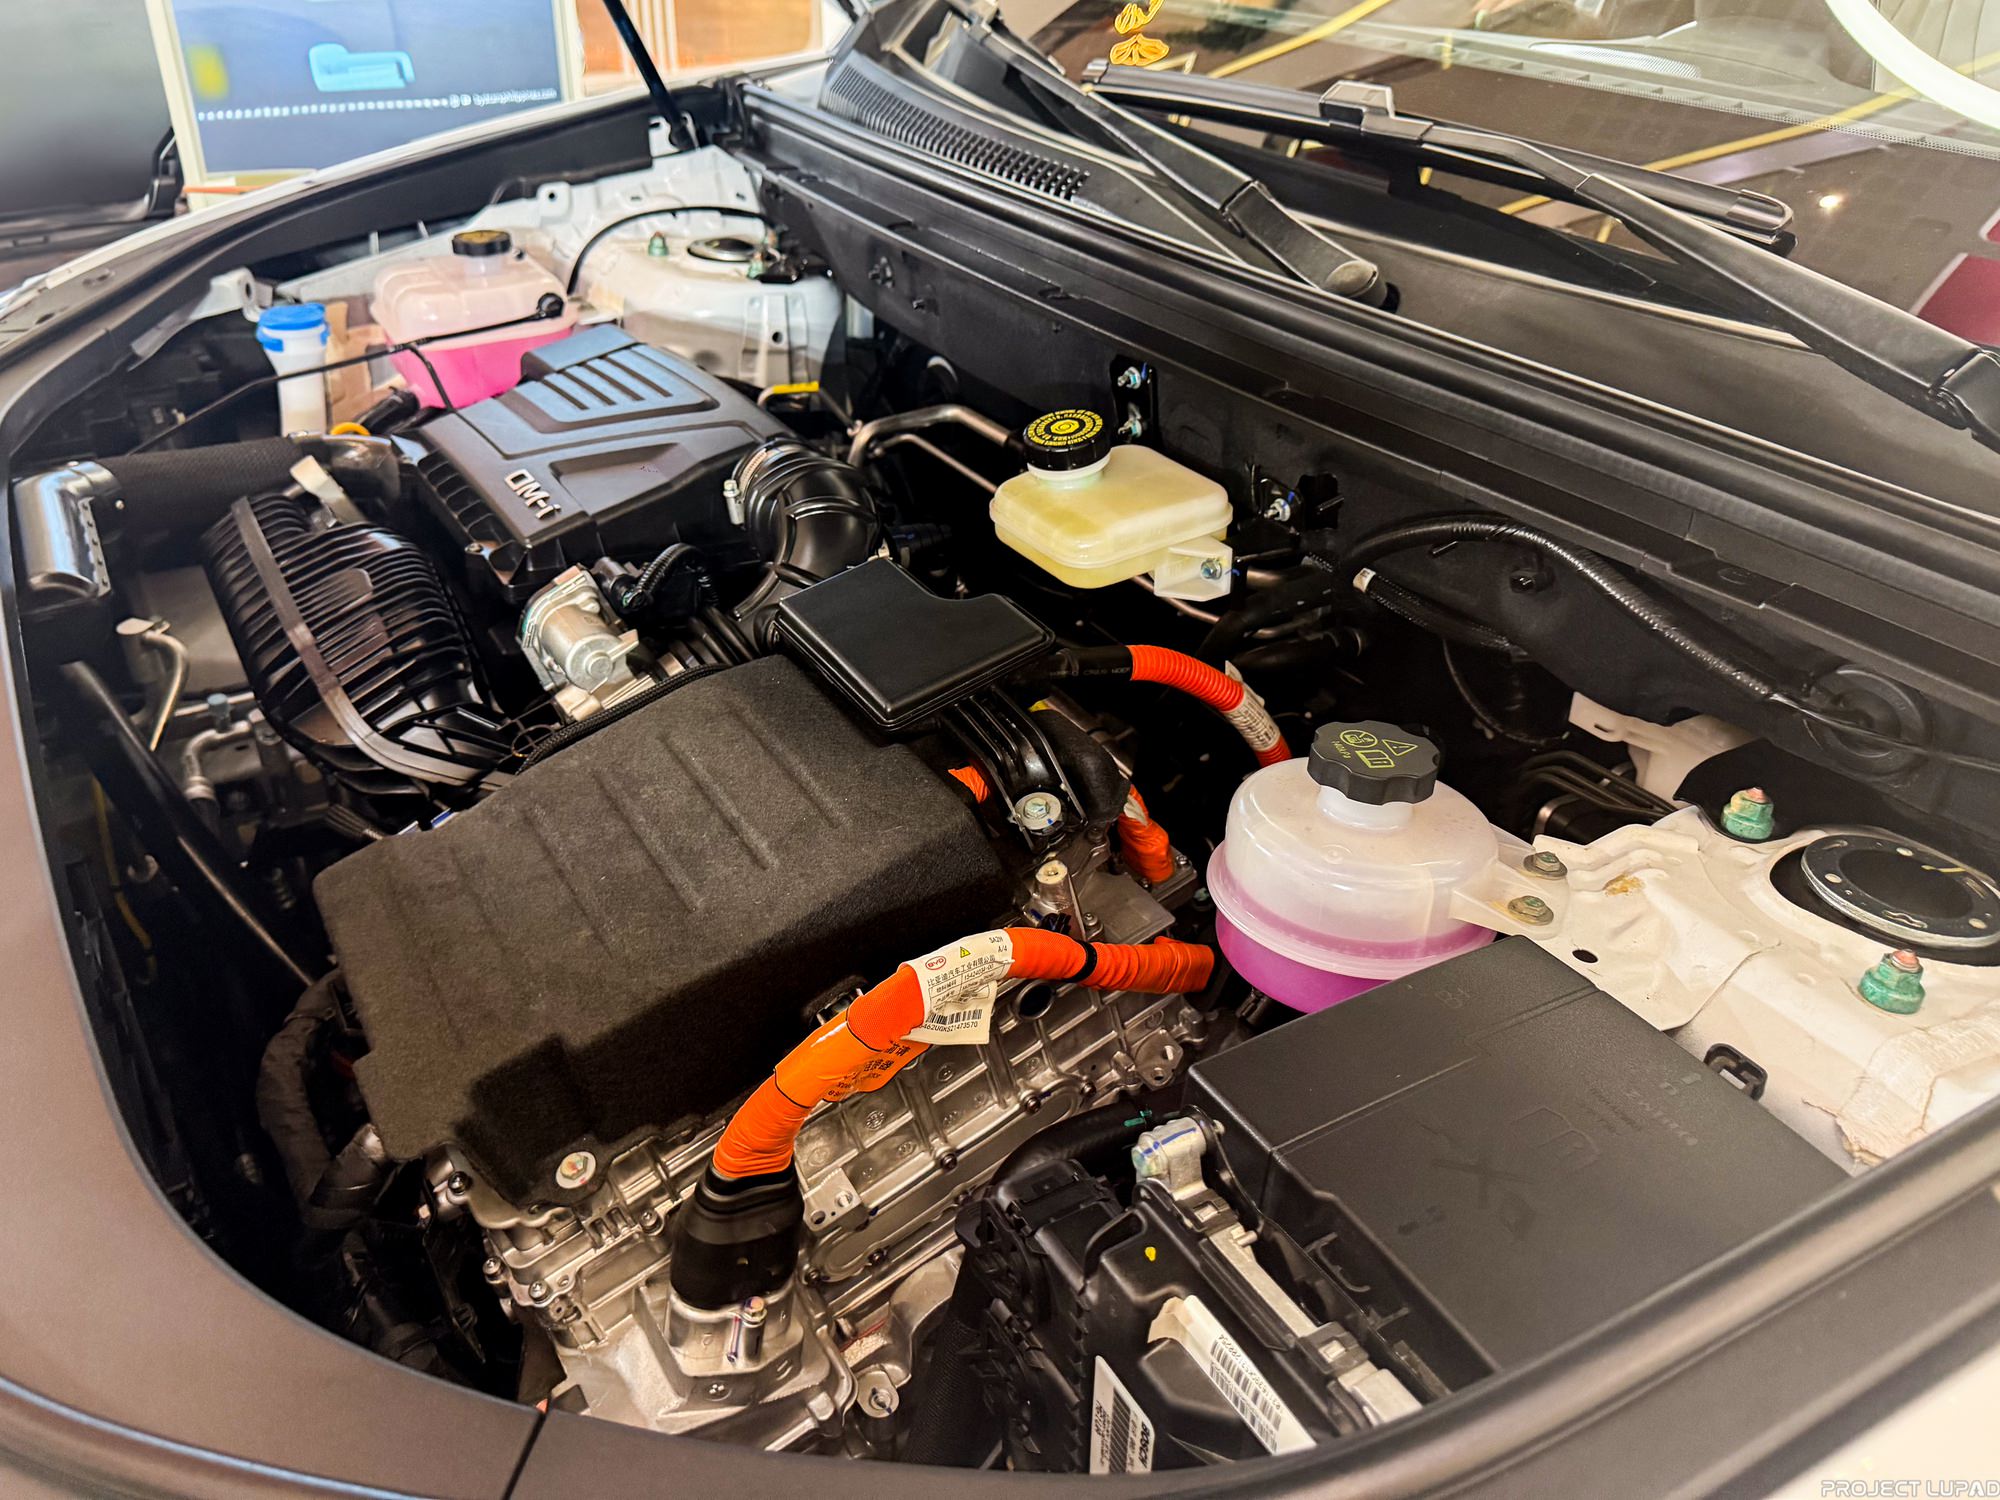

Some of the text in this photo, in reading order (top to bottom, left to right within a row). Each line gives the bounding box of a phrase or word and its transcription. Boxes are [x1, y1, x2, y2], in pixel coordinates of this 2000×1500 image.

[504, 469, 561, 519] DM-i
[927, 957, 945, 968] BYD
[1138, 1420, 1151, 1469] BOSCH
